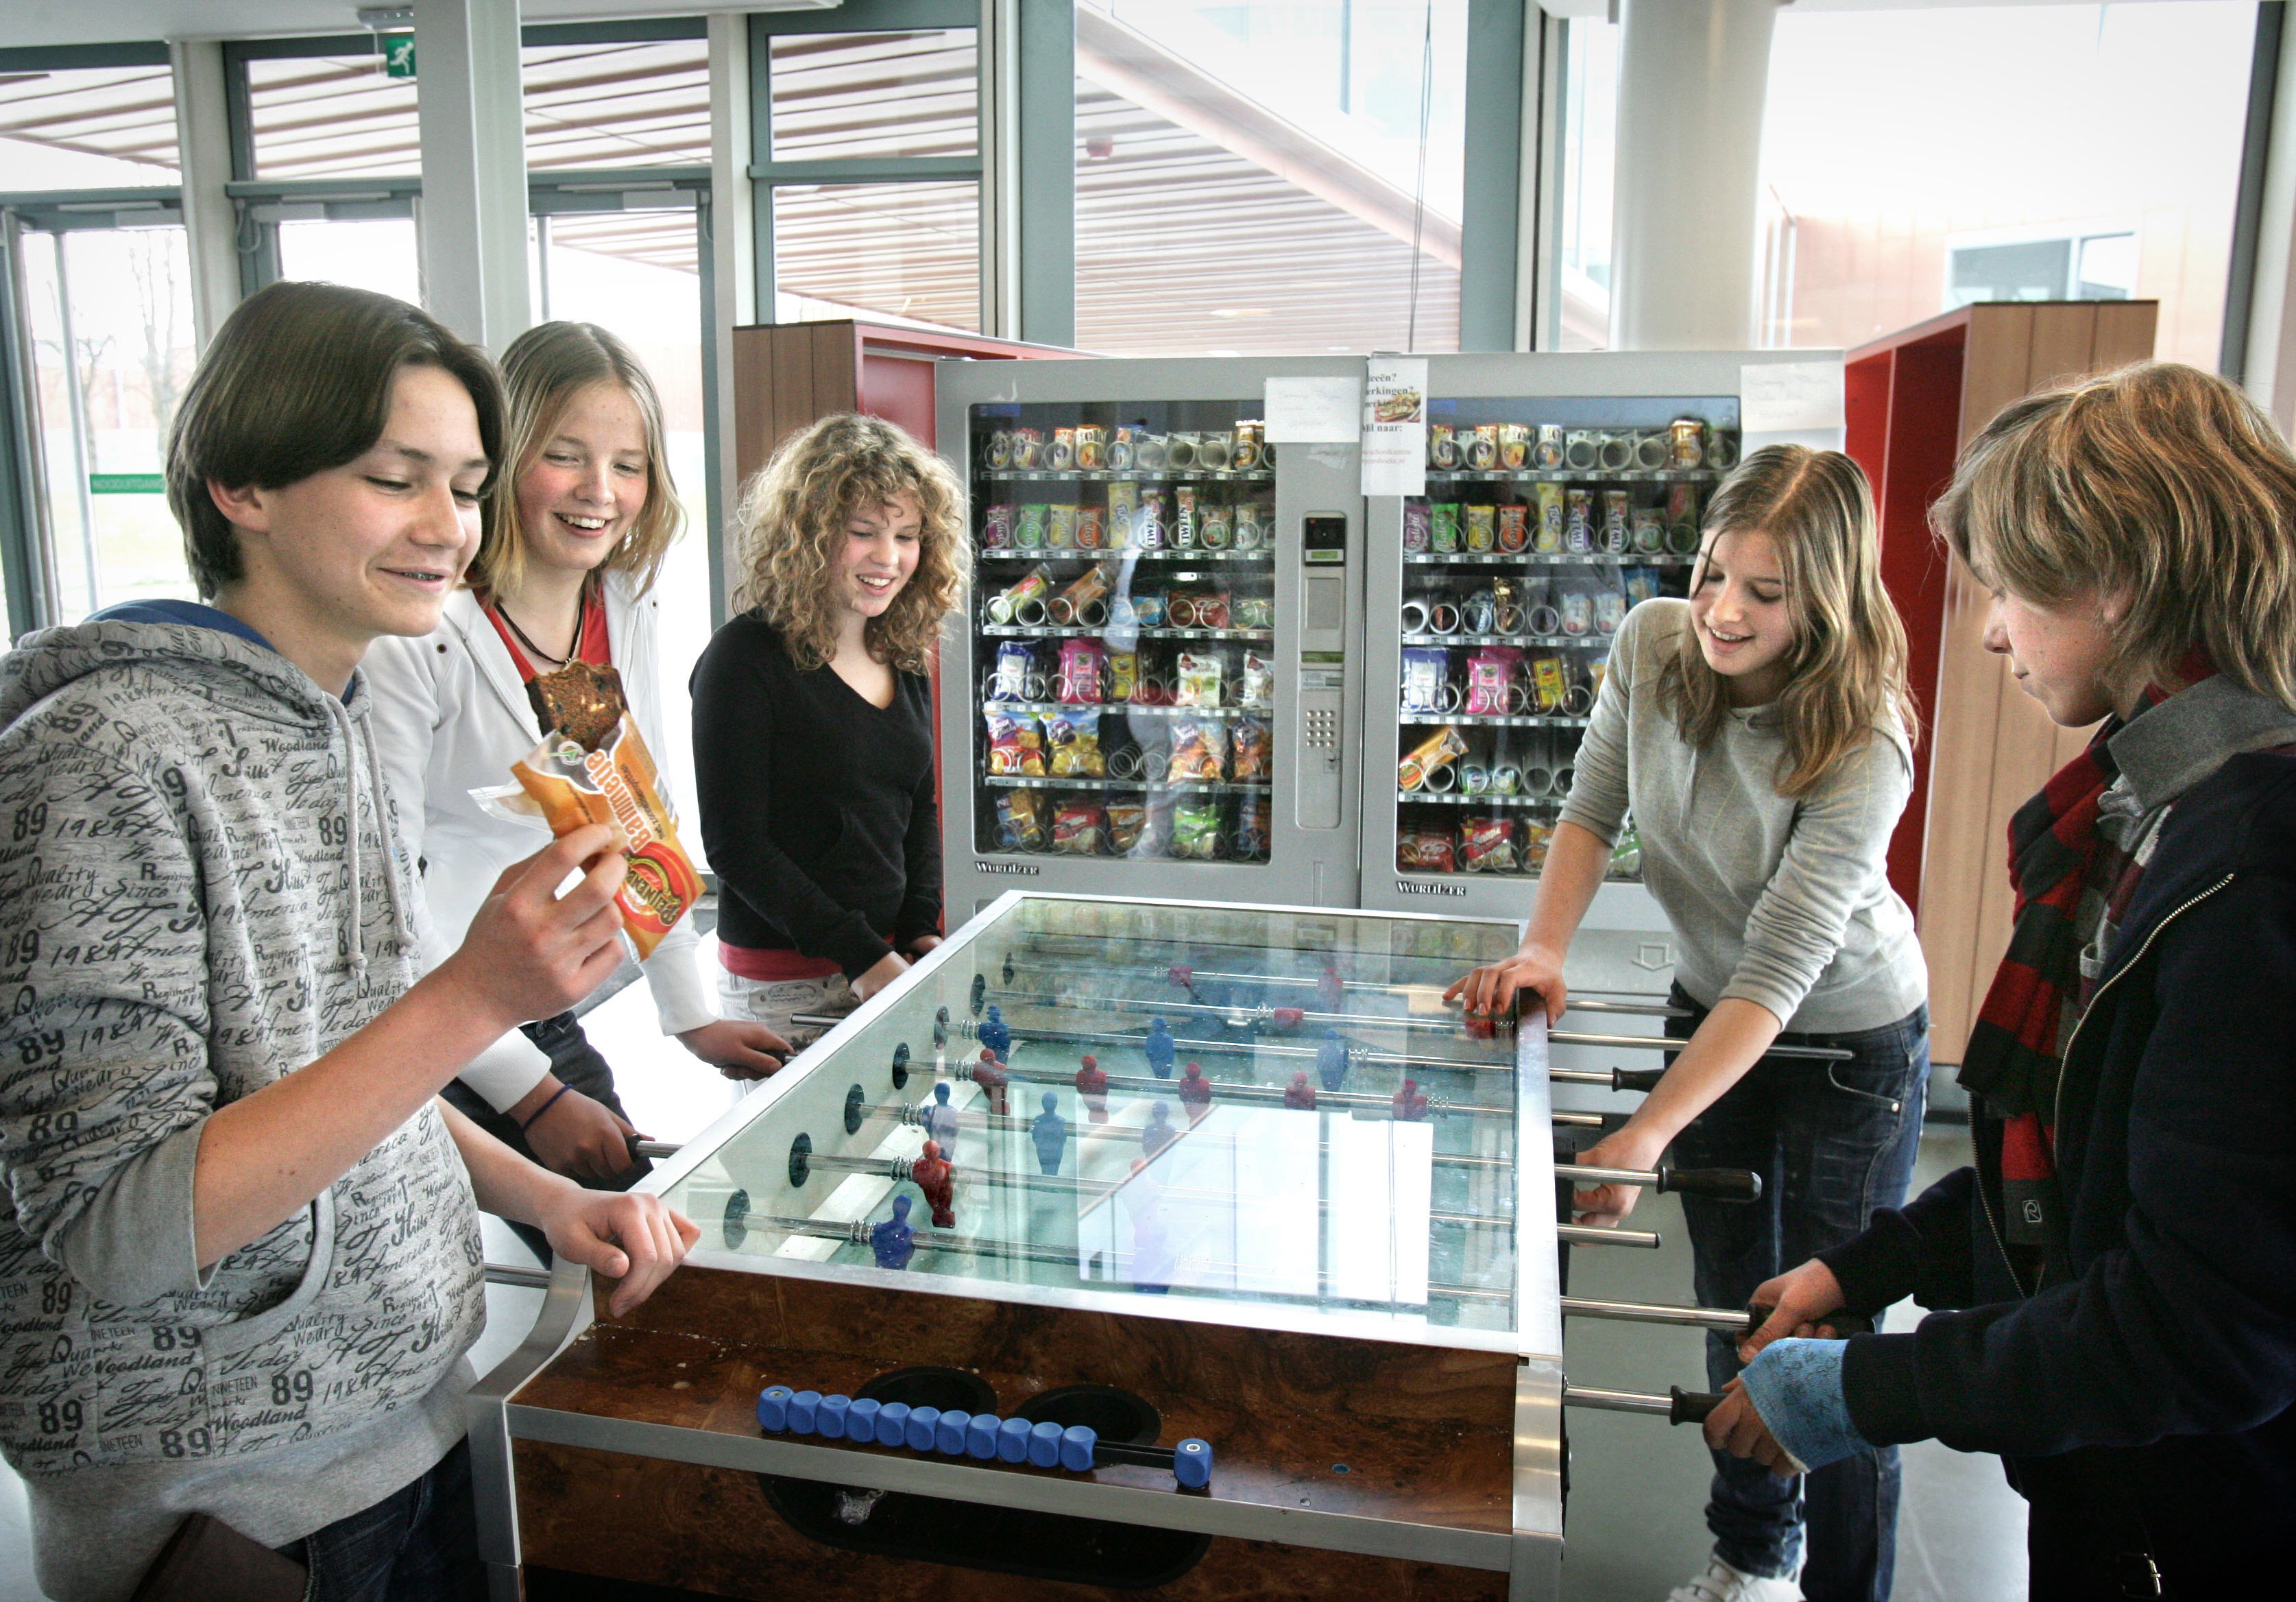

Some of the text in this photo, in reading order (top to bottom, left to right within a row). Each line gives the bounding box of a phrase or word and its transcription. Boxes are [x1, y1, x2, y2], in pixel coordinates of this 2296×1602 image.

[261, 738, 330, 752] Woodland
[584, 749, 653, 853] Bammetje
[13, 802, 48, 842] 89
[318, 815, 348, 846] 89
[295, 848, 345, 863] Woodland
[102, 878, 169, 898] Since
[5, 929, 40, 968] 89
[16, 1029, 66, 1064] 89
[42, 1281, 72, 1314] 89
[0, 1317, 64, 1333] oodland
[152, 1325, 202, 1351] 89
[271, 1370, 313, 1406] 89
[38, 1399, 84, 1435] 89
[206, 1404, 308, 1434] Woodland
[159, 1426, 212, 1459] 89
